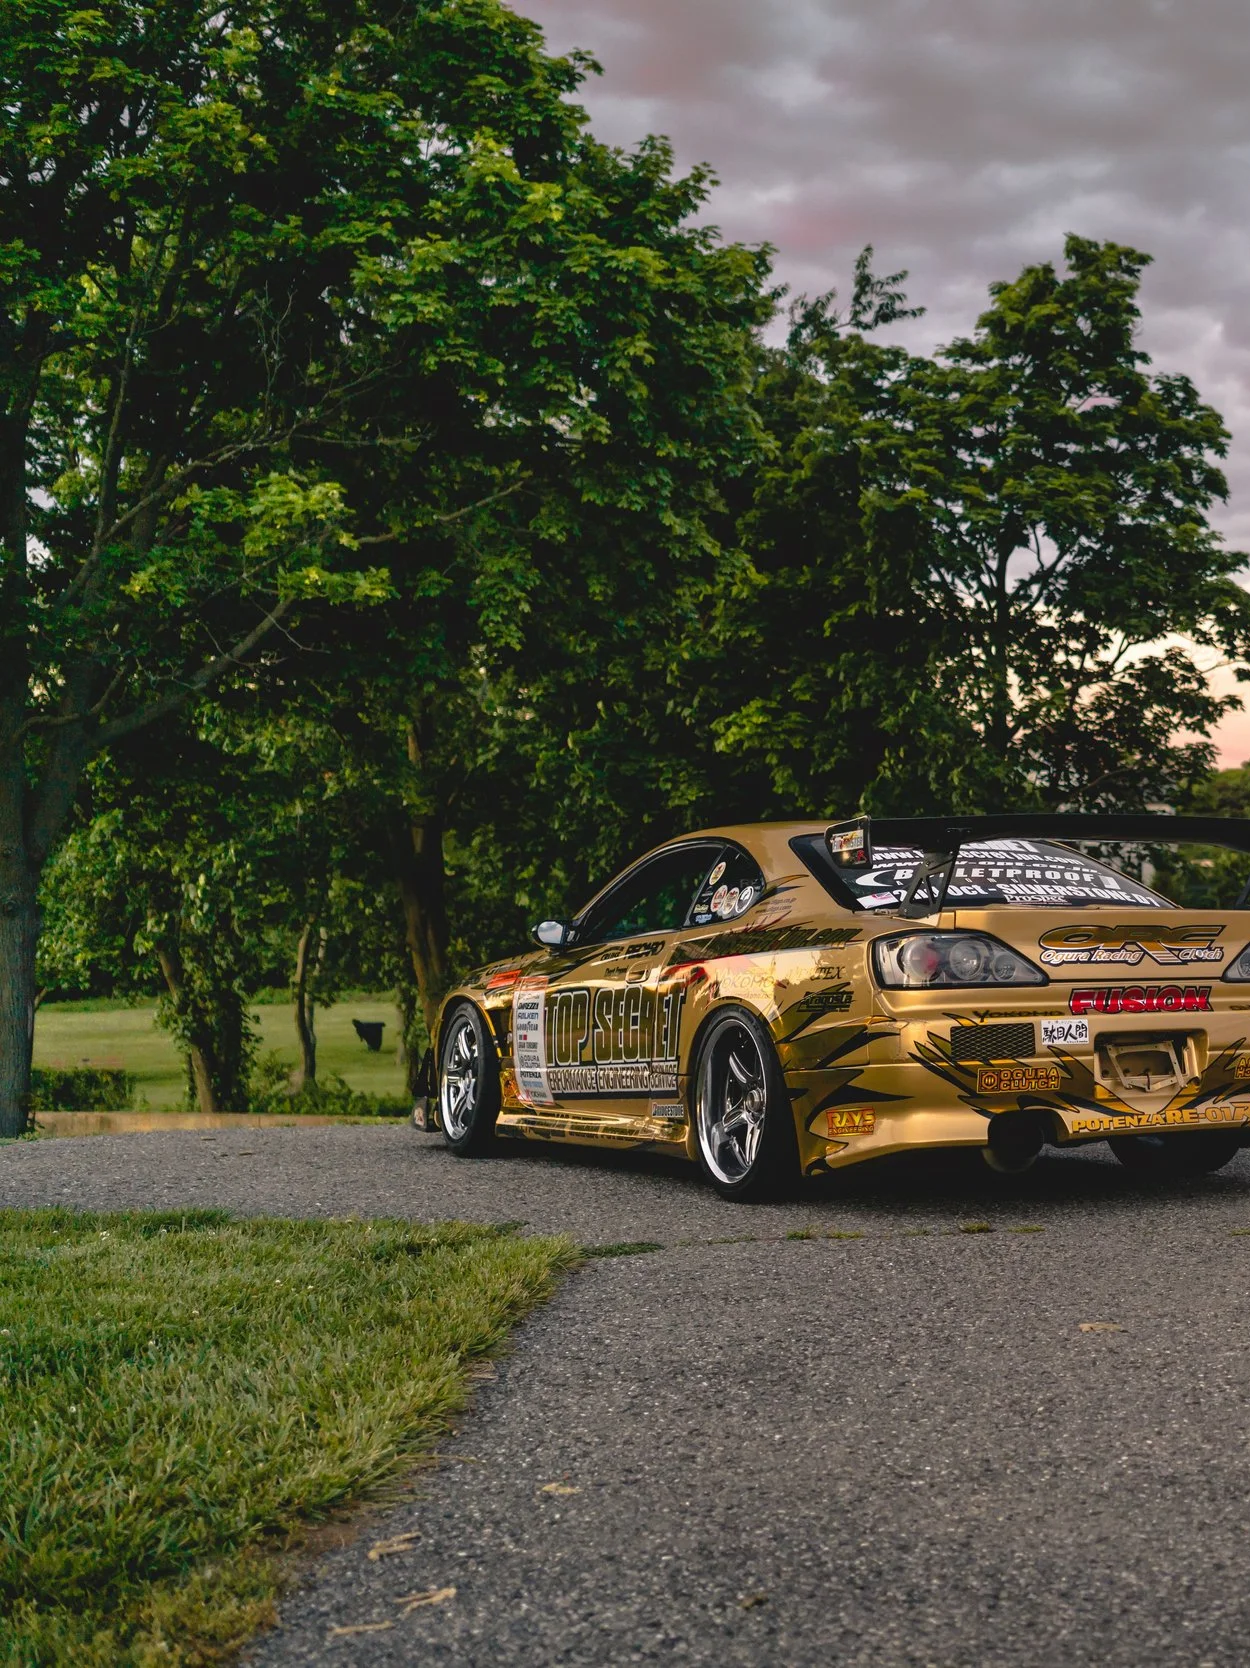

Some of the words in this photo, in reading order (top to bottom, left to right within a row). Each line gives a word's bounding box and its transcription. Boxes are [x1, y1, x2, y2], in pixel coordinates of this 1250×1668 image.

[893, 867, 1094, 882] BLETPROOF
[996, 884, 1136, 902] SILVERSTONE
[1041, 949, 1090, 964] Ogura
[1091, 949, 1143, 963] Racing
[1178, 947, 1222, 962] Cltch
[1069, 986, 1213, 1015] FUSION
[545, 990, 589, 1066] TOP
[594, 985, 685, 1063] SECRET
[548, 1067, 597, 1091] ERFORMANCE
[599, 1064, 649, 1090] ENGINEERING
[1001, 1068, 1059, 1080] OGURA
[1000, 1078, 1060, 1091] CLUTCH
[652, 1103, 684, 1117] BRIDGESTONE
[827, 1110, 876, 1128] RAYS
[1072, 1114, 1165, 1134] POTENZA
[828, 1126, 874, 1135] ENGINEERING
